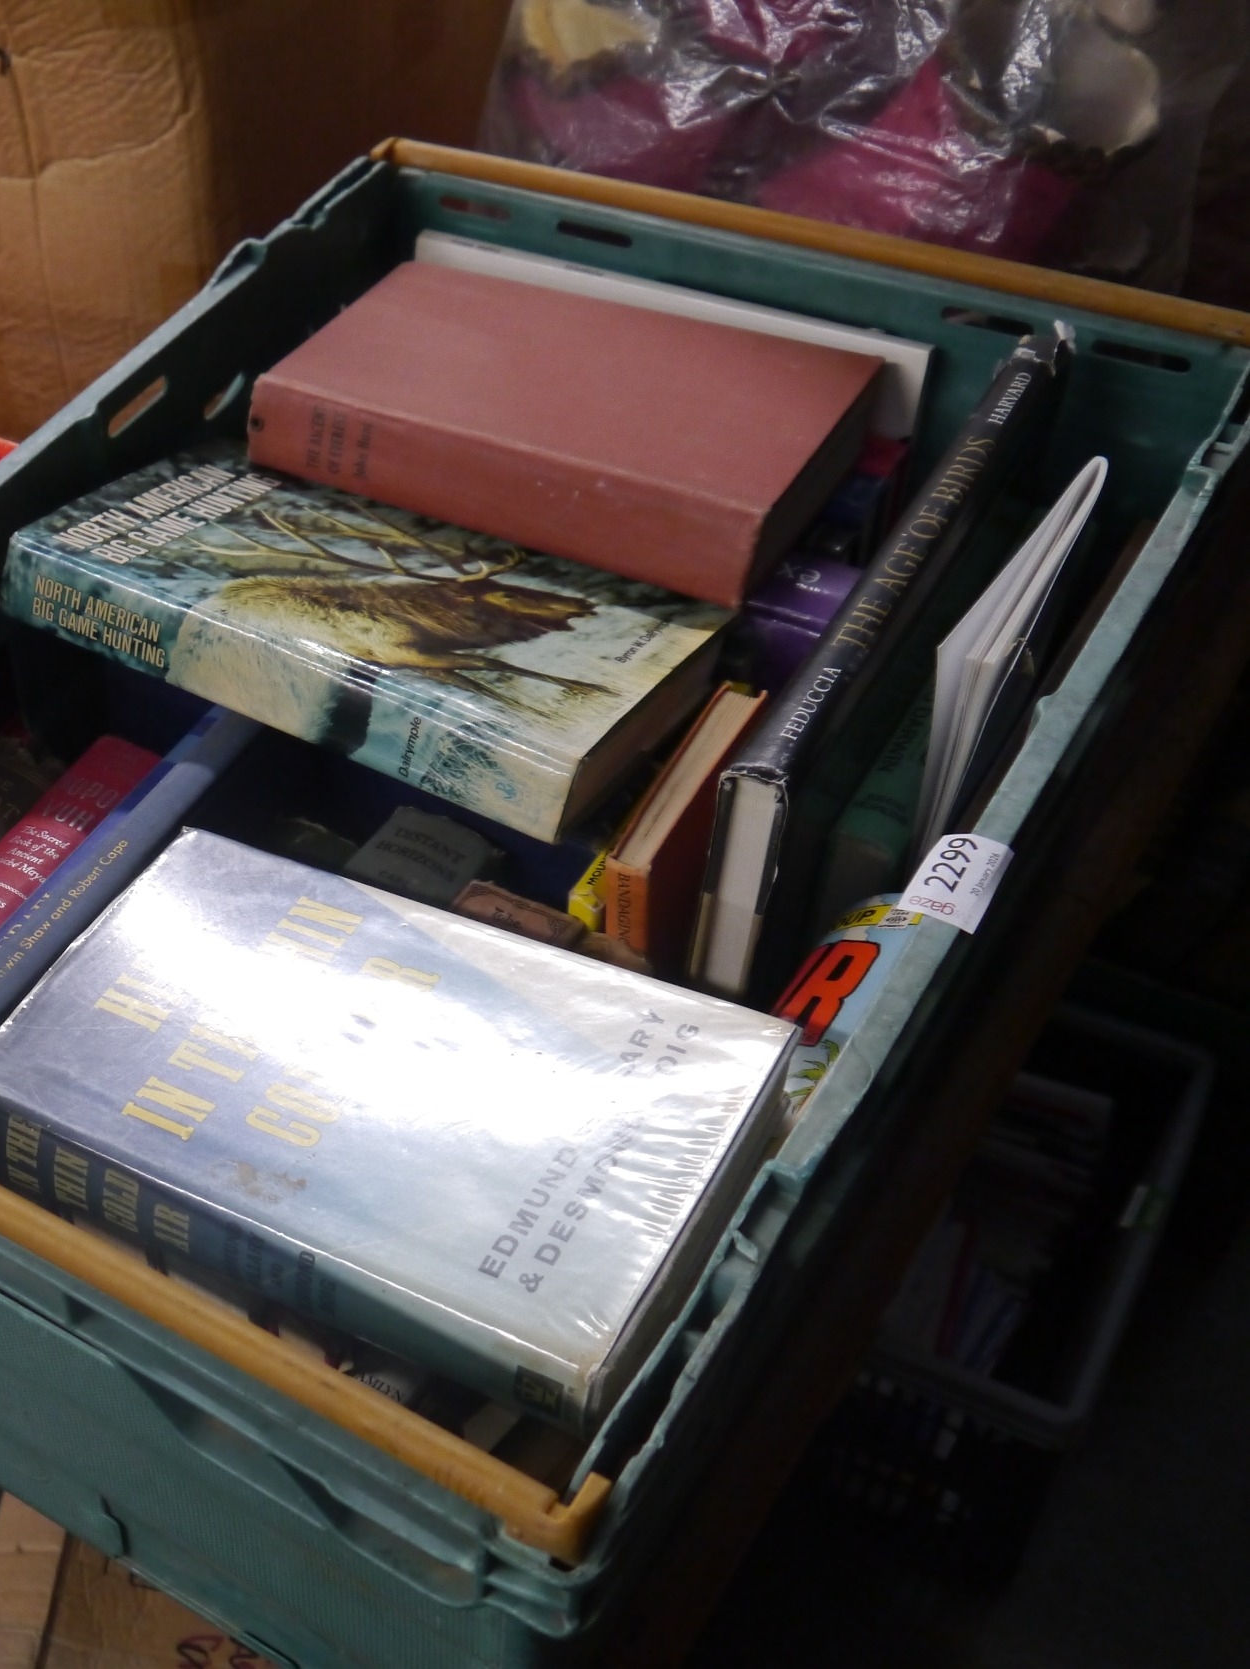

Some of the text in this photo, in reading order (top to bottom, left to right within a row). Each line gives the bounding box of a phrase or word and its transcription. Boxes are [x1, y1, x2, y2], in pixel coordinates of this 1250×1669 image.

[988, 372, 1032, 425] HARVARD
[52, 464, 235, 550] NORTH AMERICAN
[90, 473, 282, 564] BIG GAME HUNTING
[831, 436, 995, 649] THE AGE OF BIRDS
[32, 596, 166, 669] BIG GAME HUNTING
[35, 575, 161, 644] NORTH AMERICAN
[614, 647, 638, 664] Byron
[780, 666, 842, 741] FEDUCCIA
[399, 716, 422, 778] Dalrymple
[22, 825, 71, 850] The Sacred
[42, 799, 96, 832] VUH
[395, 827, 467, 863] DISTANT
[6, 847, 45, 866] Ancient
[9, 835, 60, 860] Book of the
[924, 837, 979, 893] 2299
[970, 852, 1001, 896] 20 January 2026
[21, 921, 52, 950] Shaw
[50, 898, 73, 921] and
[68, 864, 105, 899] Robert
[99, 839, 130, 866] Capa
[909, 895, 956, 916] gaze
[121, 1075, 217, 1142] IN
[6, 1113, 42, 1194] IN THE
[54, 1145, 89, 1212] THIN
[102, 1167, 140, 1234] COLD
[153, 1203, 190, 1253] AIR
[477, 1145, 579, 1280] EDMUND
[518, 1271, 544, 1294] &
